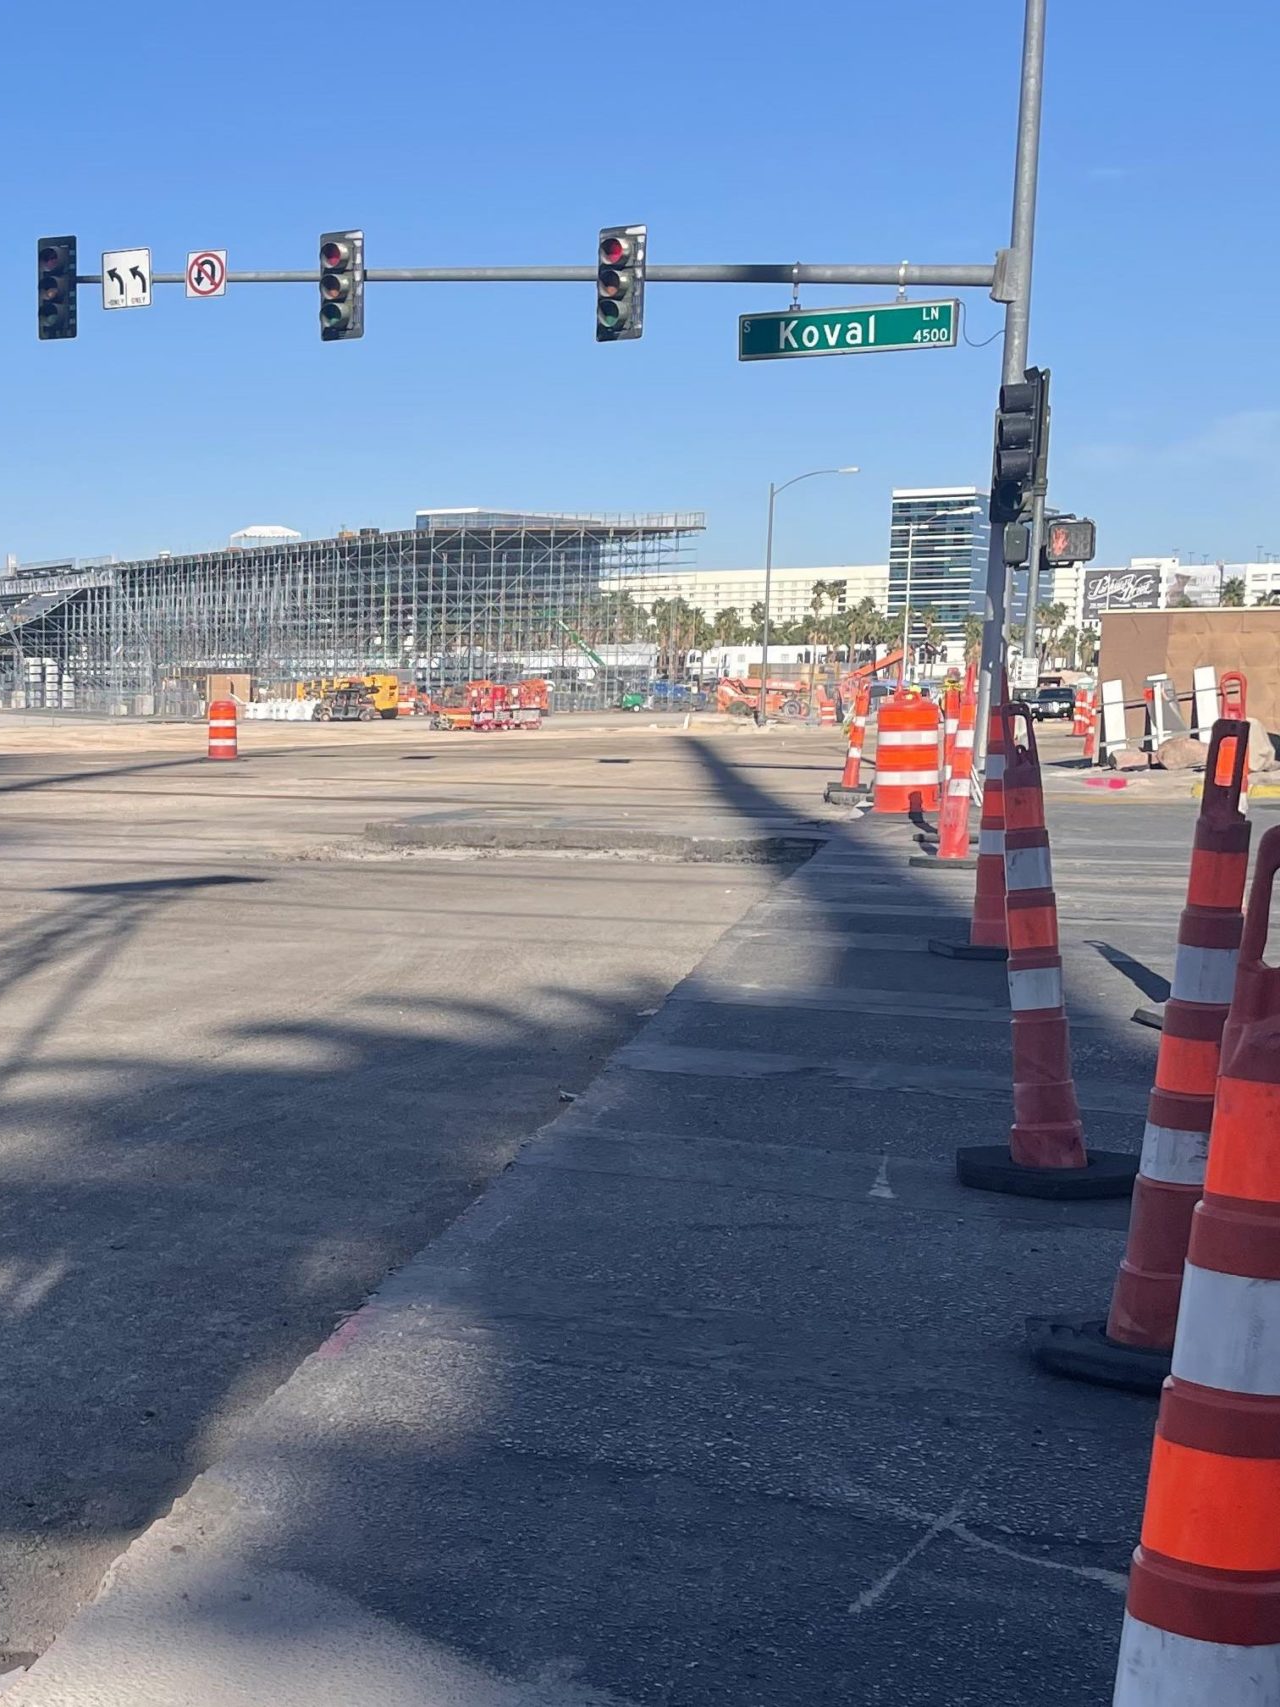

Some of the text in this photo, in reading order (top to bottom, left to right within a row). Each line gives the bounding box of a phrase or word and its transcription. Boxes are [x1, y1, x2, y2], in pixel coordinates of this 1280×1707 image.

[744, 307, 939, 350] S Koval LN
[913, 328, 948, 343] 4500
